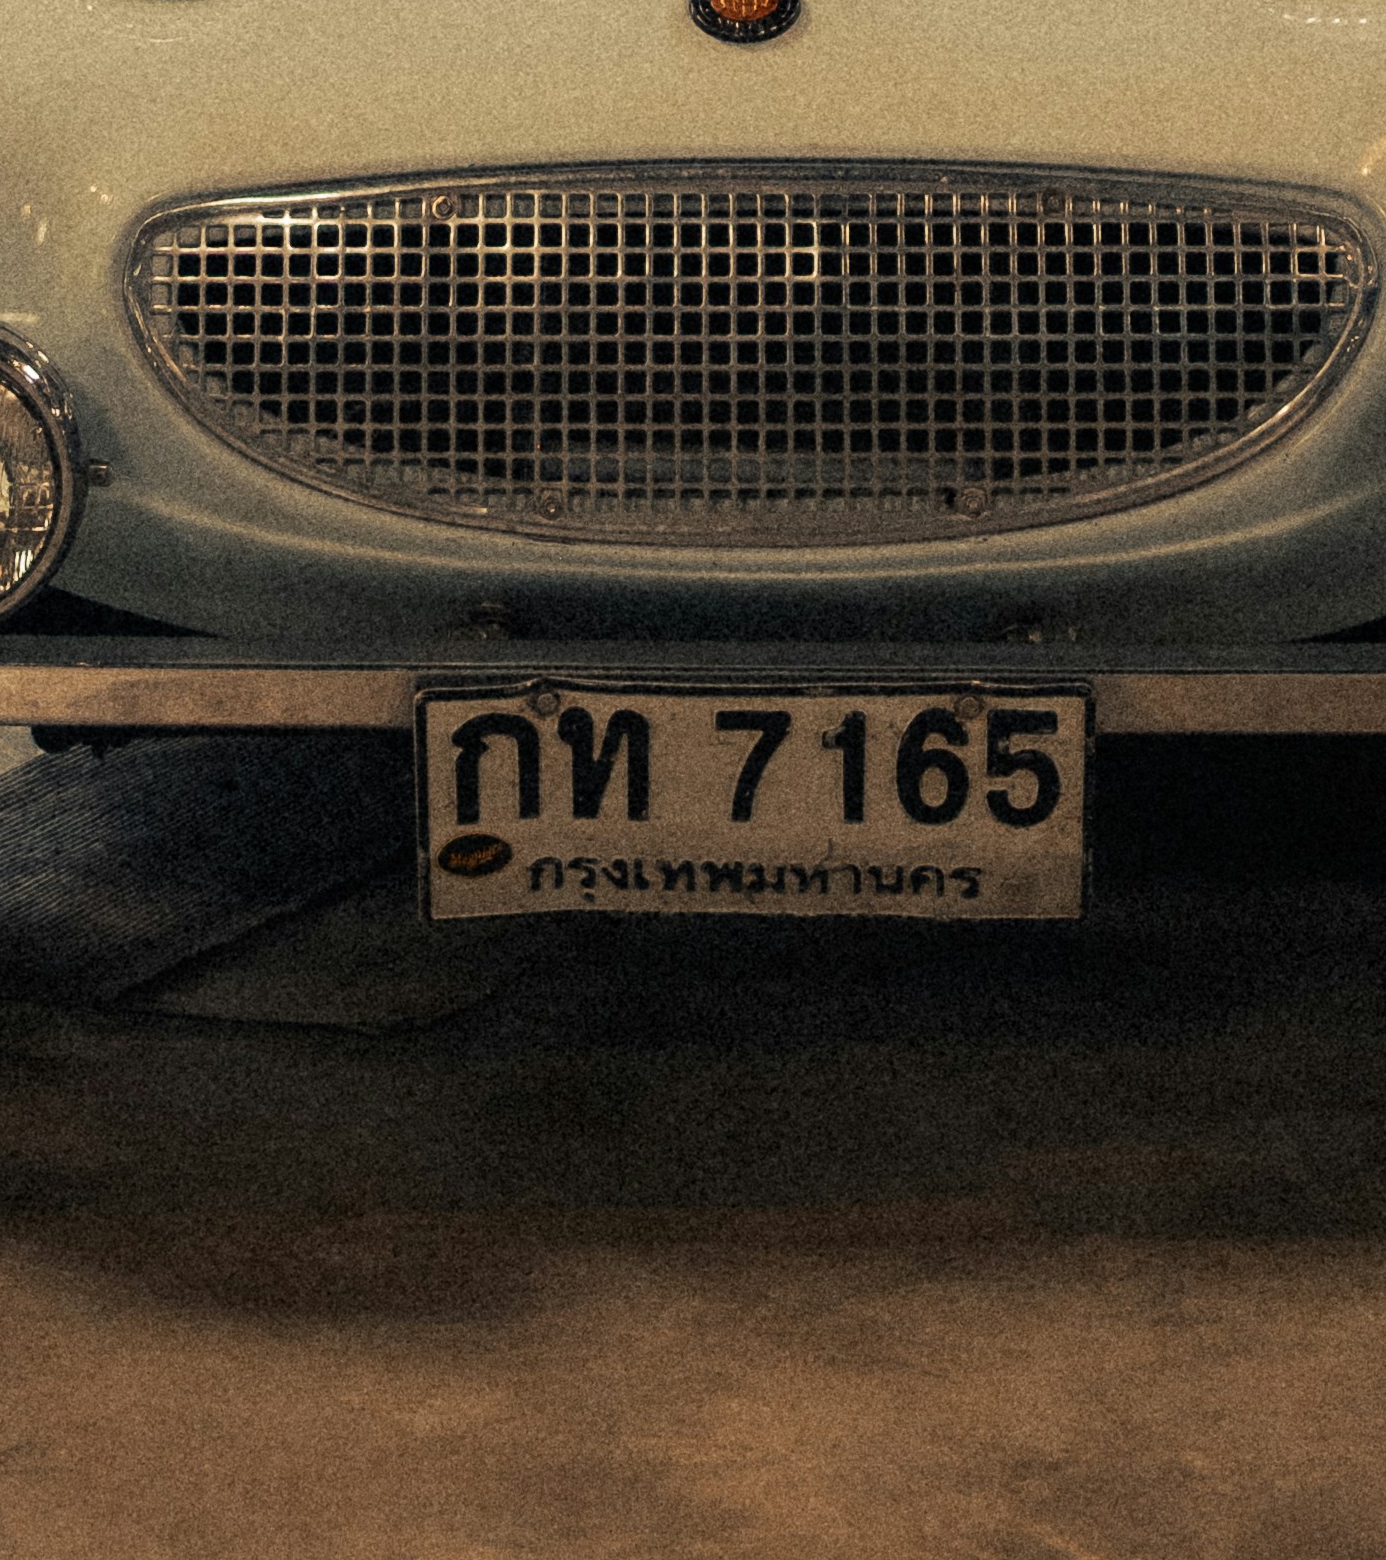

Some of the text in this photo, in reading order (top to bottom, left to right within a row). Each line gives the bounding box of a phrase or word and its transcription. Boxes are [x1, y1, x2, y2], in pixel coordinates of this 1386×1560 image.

[451, 706, 1061, 826] กท 7165
[528, 855, 983, 903] กรุงเทพมหานคร
